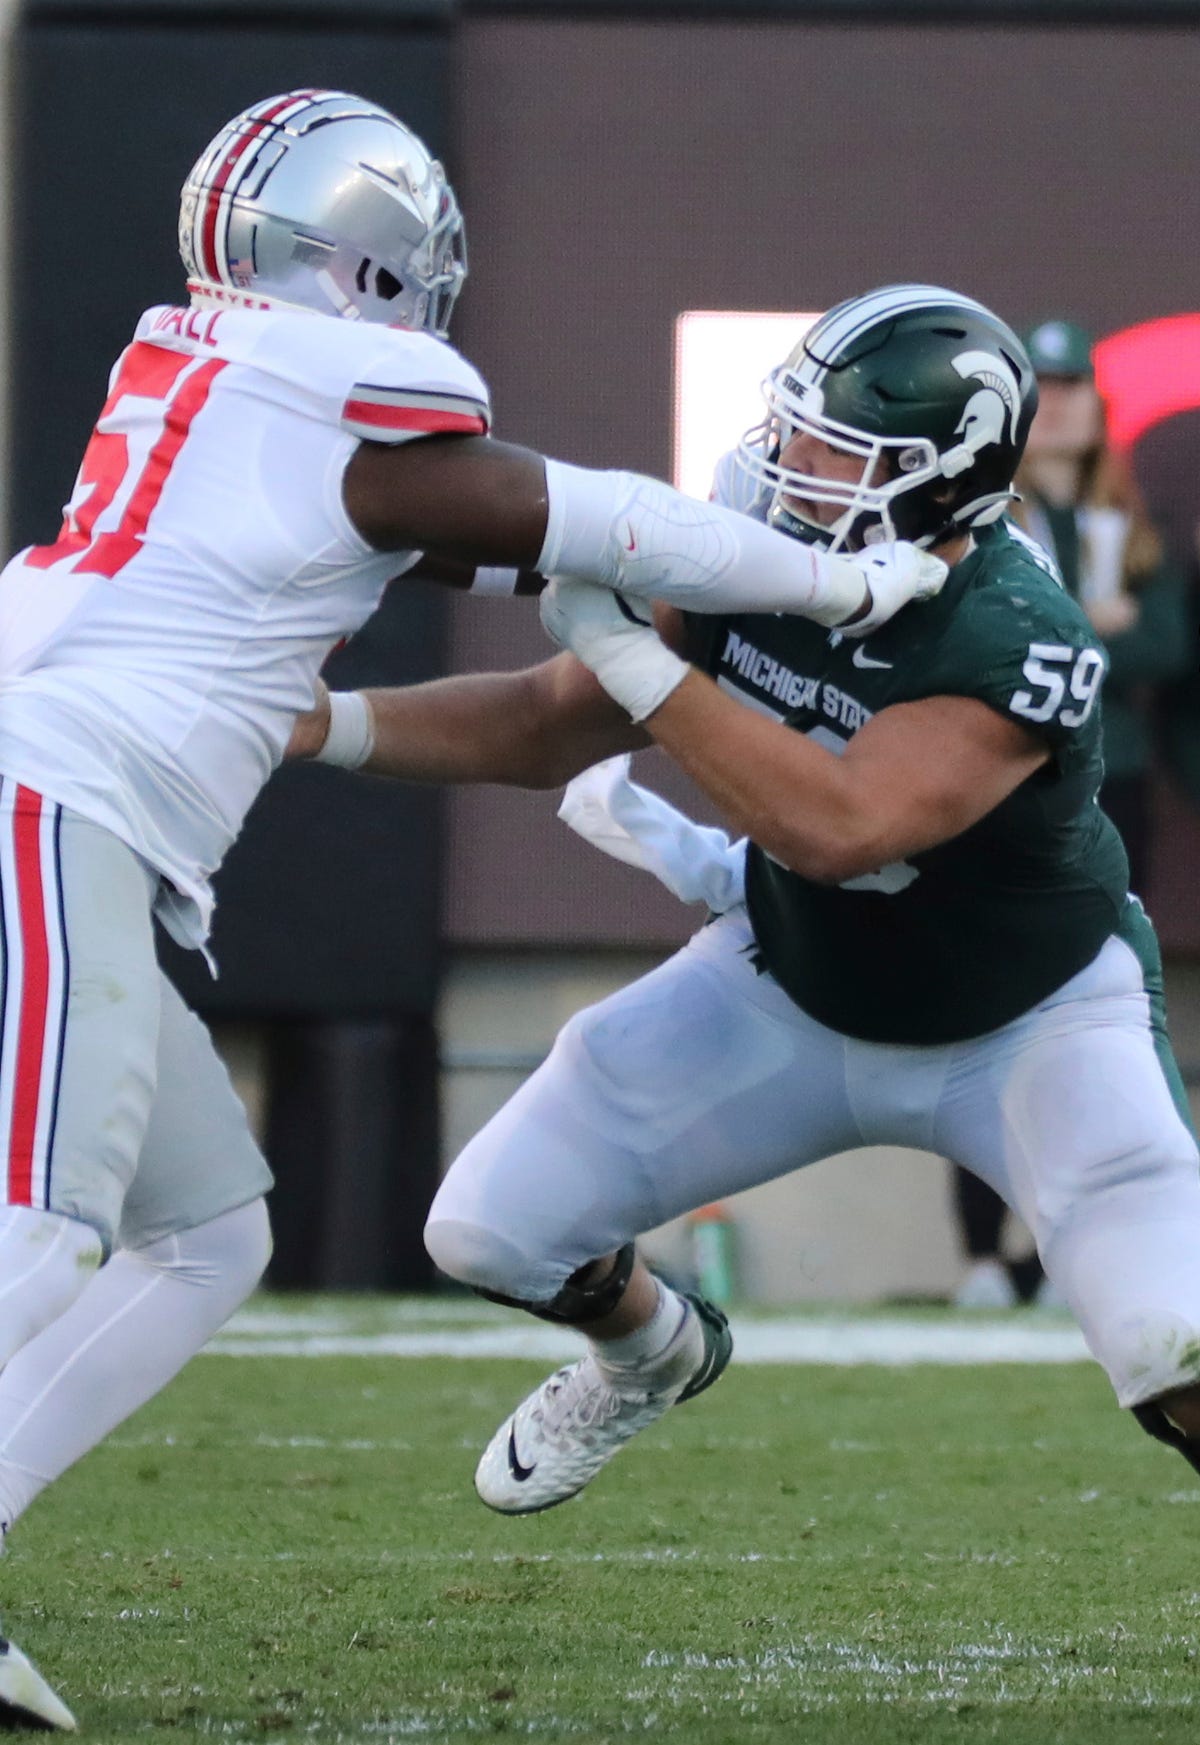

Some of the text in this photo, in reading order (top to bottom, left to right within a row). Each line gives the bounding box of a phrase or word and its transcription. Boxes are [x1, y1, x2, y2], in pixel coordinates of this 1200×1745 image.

[23, 340, 231, 580] 51
[822, 683, 875, 734] STA
[1008, 642, 1104, 728] 59
